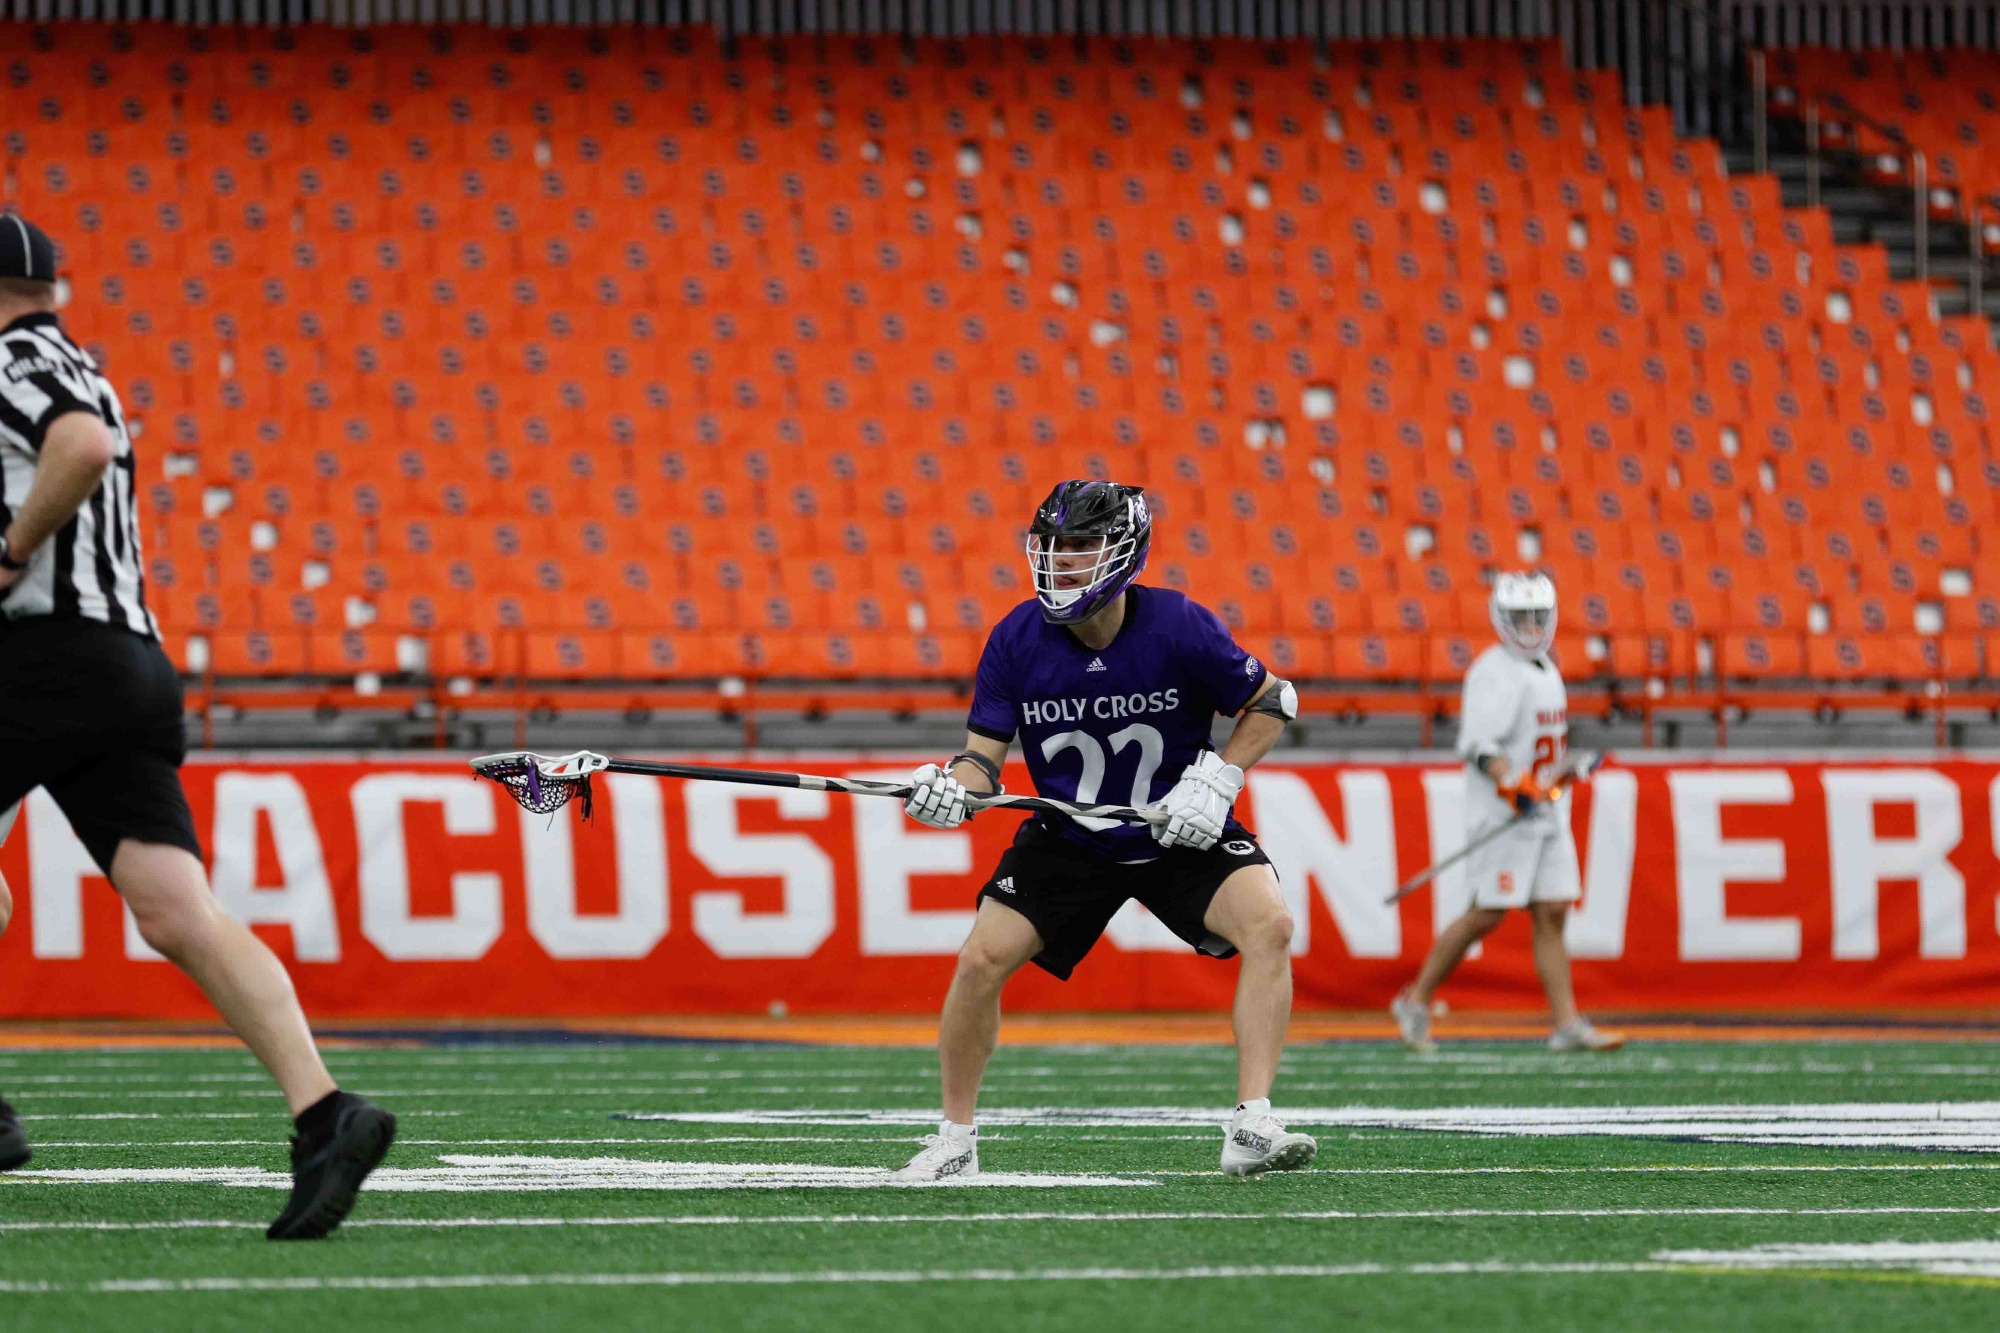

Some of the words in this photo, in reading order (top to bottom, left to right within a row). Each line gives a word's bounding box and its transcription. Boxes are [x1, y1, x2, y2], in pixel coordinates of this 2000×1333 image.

[1022, 698, 1087, 725] HOLY
[1093, 688, 1180, 719] CROSS
[1041, 722, 1164, 832] 22
